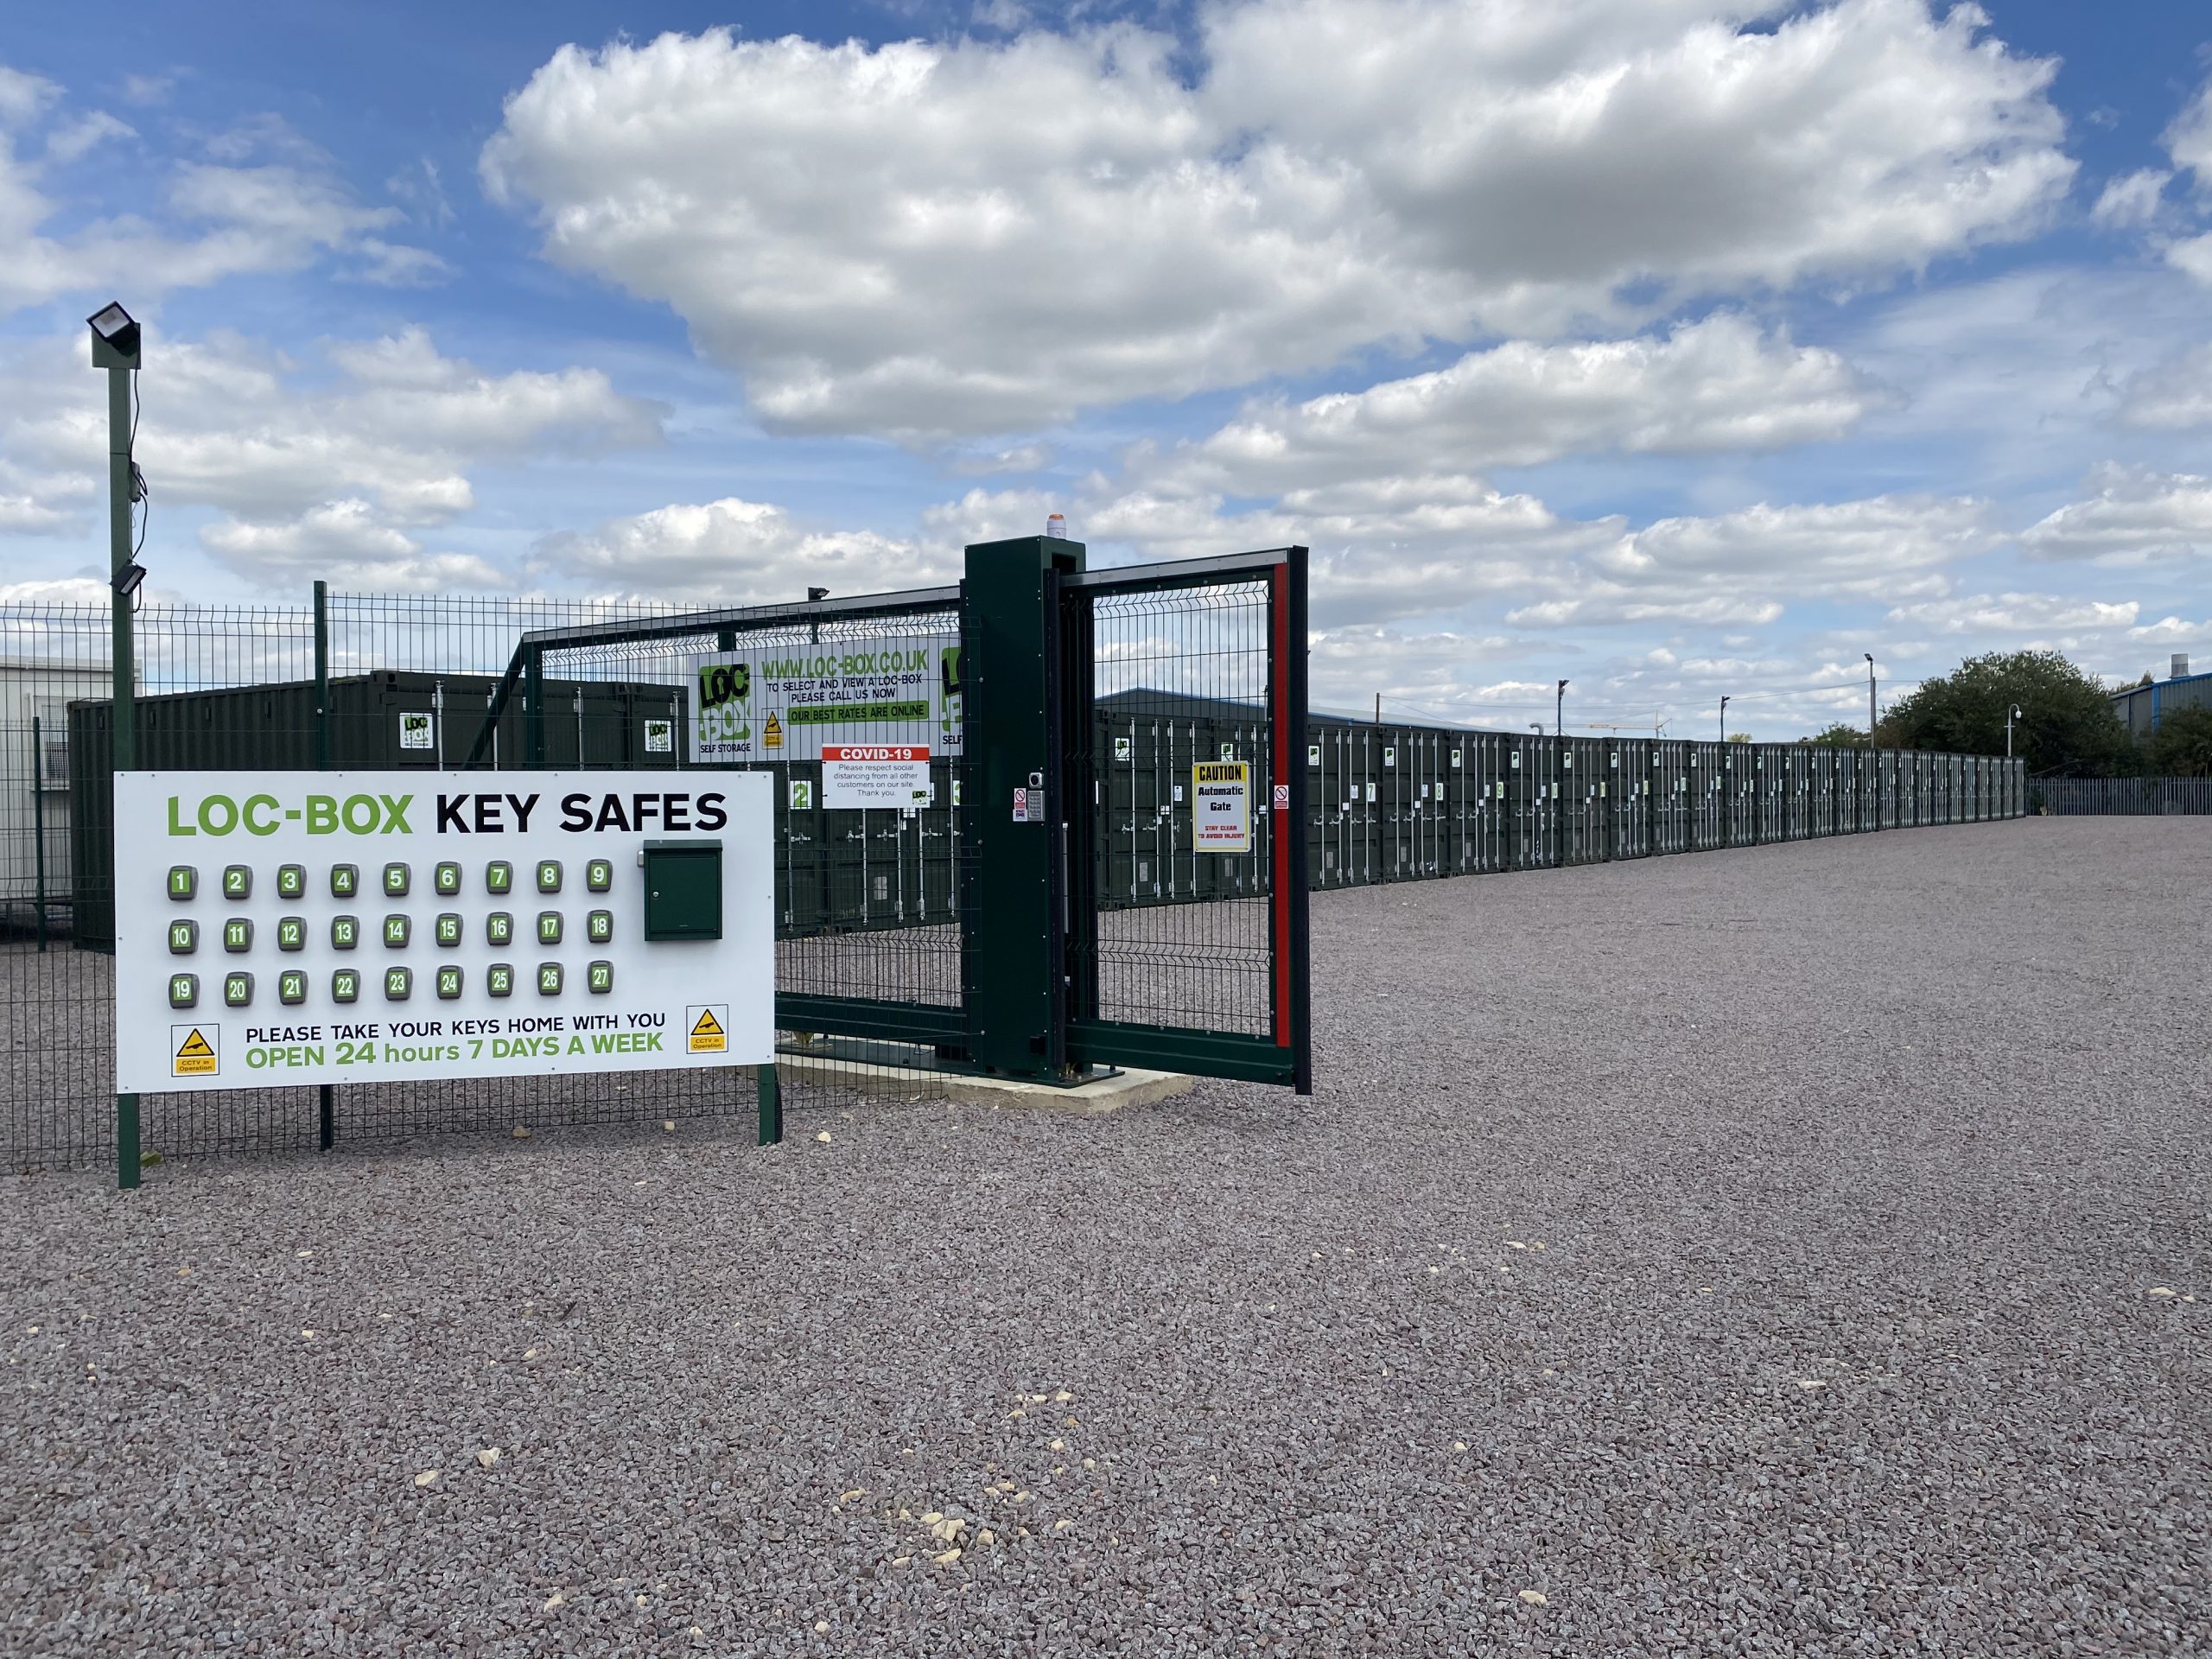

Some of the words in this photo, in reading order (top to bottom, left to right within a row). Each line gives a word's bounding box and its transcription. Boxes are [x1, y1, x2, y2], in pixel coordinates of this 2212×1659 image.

[761, 649, 928, 680] WWW.LOC-BOX.CO.UK
[700, 664, 750, 709] LOC
[767, 683, 778, 692] TO
[783, 680, 816, 692] SELECT
[819, 678, 838, 690] AND
[842, 677, 864, 689] VIEW
[868, 677, 874, 686] A
[878, 673, 922, 685] LOC-BOX
[791, 692, 825, 702] PLEASE
[829, 690, 851, 701] CALL
[855, 690, 868, 700] US
[873, 688, 896, 698] NOW
[791, 710, 810, 721] OUR
[813, 709, 836, 721] BEST
[838, 708, 867, 720] RATES
[871, 706, 887, 717] ARE
[891, 704, 924, 716] ONLINE
[701, 744, 716, 753] SELF
[718, 743, 751, 753] STORAGE
[840, 748, 912, 760] COVID-19
[865, 764, 892, 772] respect
[1199, 765, 1242, 781] CAUTION
[793, 783, 808, 807] 2
[1198, 785, 1243, 796] Automatic
[1369, 785, 1374, 800] 7
[168, 794, 415, 836] LOC-BOX
[436, 793, 540, 834] KEY
[559, 792, 728, 832] SAFES
[1211, 802, 1231, 811] Gate
[176, 874, 184, 890] 1
[230, 873, 242, 889] 2
[284, 873, 296, 888] 3
[336, 872, 349, 888] 4
[390, 870, 402, 887] 5
[442, 869, 454, 886] 6
[493, 868, 505, 885] 7
[543, 868, 555, 884] 8
[593, 867, 605, 882] 9
[174, 927, 188, 944] 10
[230, 926, 244, 943] 11
[283, 925, 297, 942] 12
[337, 924, 351, 940] 13
[389, 922, 403, 938] 14
[442, 921, 455, 937] 15
[493, 919, 506, 935] 16
[543, 919, 556, 934] 17
[594, 918, 607, 933] 18
[175, 981, 190, 998] 19
[229, 980, 245, 997] 20
[285, 978, 300, 995] 21
[338, 977, 352, 994] 22
[391, 975, 404, 991] 23
[442, 975, 456, 990] 24
[493, 972, 507, 988] 25
[543, 970, 557, 987] 26
[594, 969, 607, 985] 27
[246, 1026, 321, 1043] PLEASE
[331, 1024, 379, 1039] TAKE
[388, 1021, 442, 1038] YOUR
[452, 1019, 500, 1035] KEYS
[508, 1017, 563, 1033] HOME
[572, 1014, 618, 1030] WITH
[626, 1013, 665, 1028] YOU
[245, 1046, 325, 1069] OPEN
[335, 1041, 376, 1065] 24
[385, 1043, 460, 1063] hours
[467, 1039, 483, 1059] 7
[493, 1036, 560, 1058] DAYS
[567, 1035, 586, 1055] A
[591, 1032, 664, 1053] WEEK
